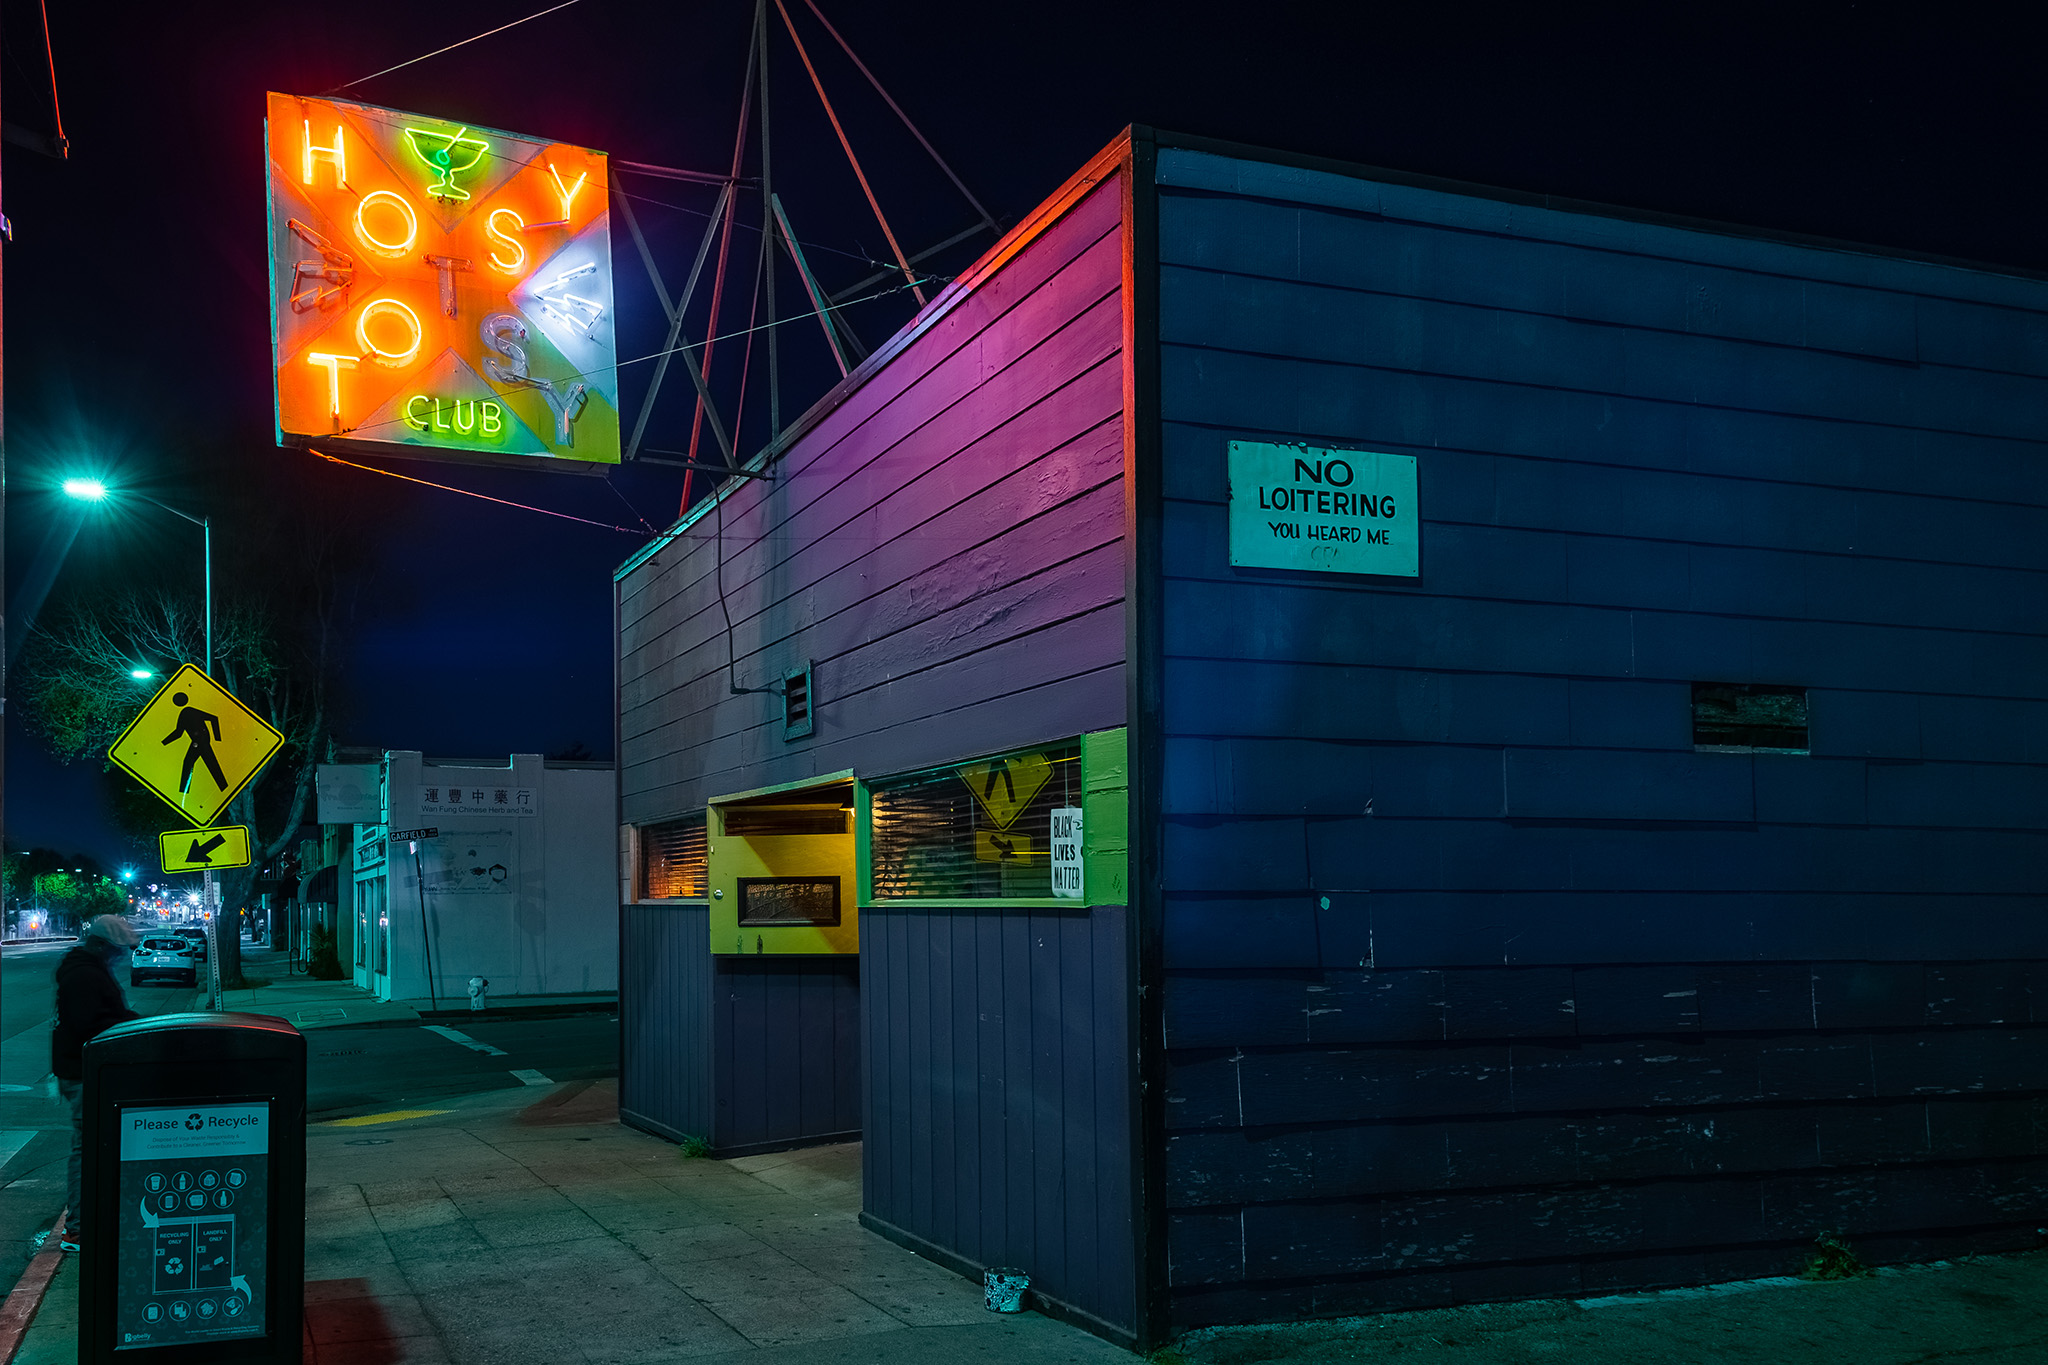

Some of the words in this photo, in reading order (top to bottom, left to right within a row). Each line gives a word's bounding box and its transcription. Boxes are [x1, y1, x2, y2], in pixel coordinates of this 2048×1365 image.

[405, 394, 503, 436] CLUB
[1294, 458, 1354, 488] NO
[1258, 486, 1396, 519] LOITERING
[1267, 521, 1300, 539] YOU
[1307, 524, 1361, 544] HEARD
[1367, 528, 1391, 546] ME
[424, 788, 531, 805] 運豐中藥行
[421, 805, 437, 813] Wan
[439, 805, 457, 814] Fung
[458, 805, 487, 814] Chinese
[488, 806, 506, 814] Herb
[507, 806, 520, 814] and
[521, 807, 534, 815] Tea
[390, 829, 426, 842] GARFIELD
[1053, 815, 1073, 838] BLACK
[1054, 844, 1076, 861] LIVES
[1054, 867, 1080, 890] MATTER
[134, 1118, 179, 1130] Please
[208, 1114, 259, 1129] Recycle
[159, 1231, 190, 1239] RECYCLING
